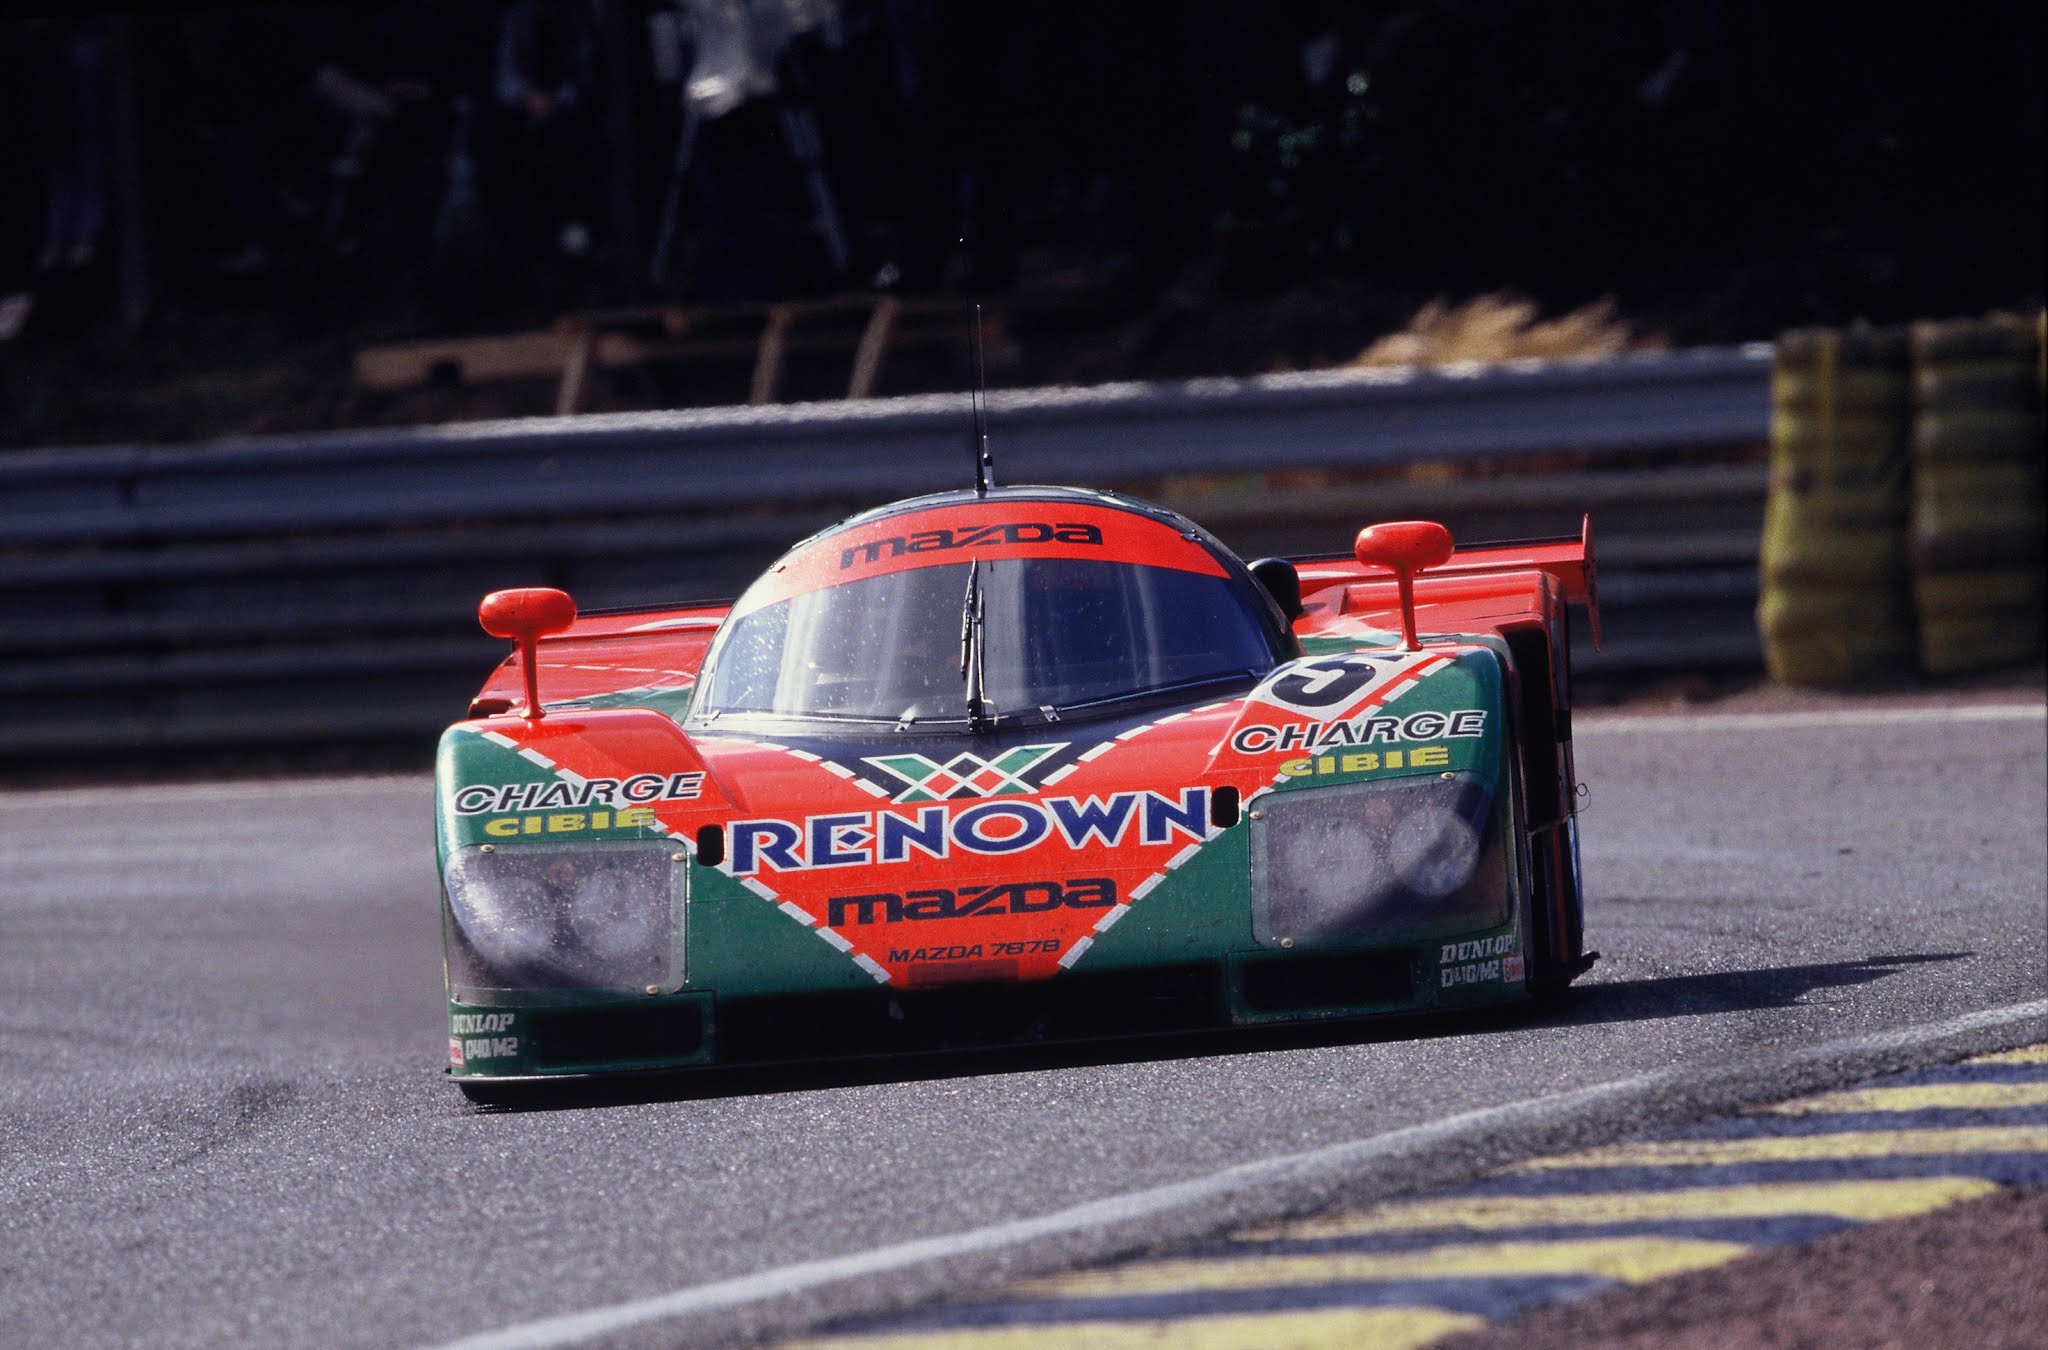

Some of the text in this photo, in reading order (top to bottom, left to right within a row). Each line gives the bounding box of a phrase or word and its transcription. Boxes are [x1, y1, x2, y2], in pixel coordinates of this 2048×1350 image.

[1231, 709, 1488, 754] CHARGE
[1278, 746, 1449, 777] CIBIE
[454, 771, 707, 816] CHARGE
[484, 806, 656, 837] CIBIE
[726, 786, 1213, 876] RENOWN
[888, 938, 1061, 963] MAZDA 787B
[1439, 933, 1513, 964] DUNLOP
[453, 1013, 515, 1034] DUNLOP
